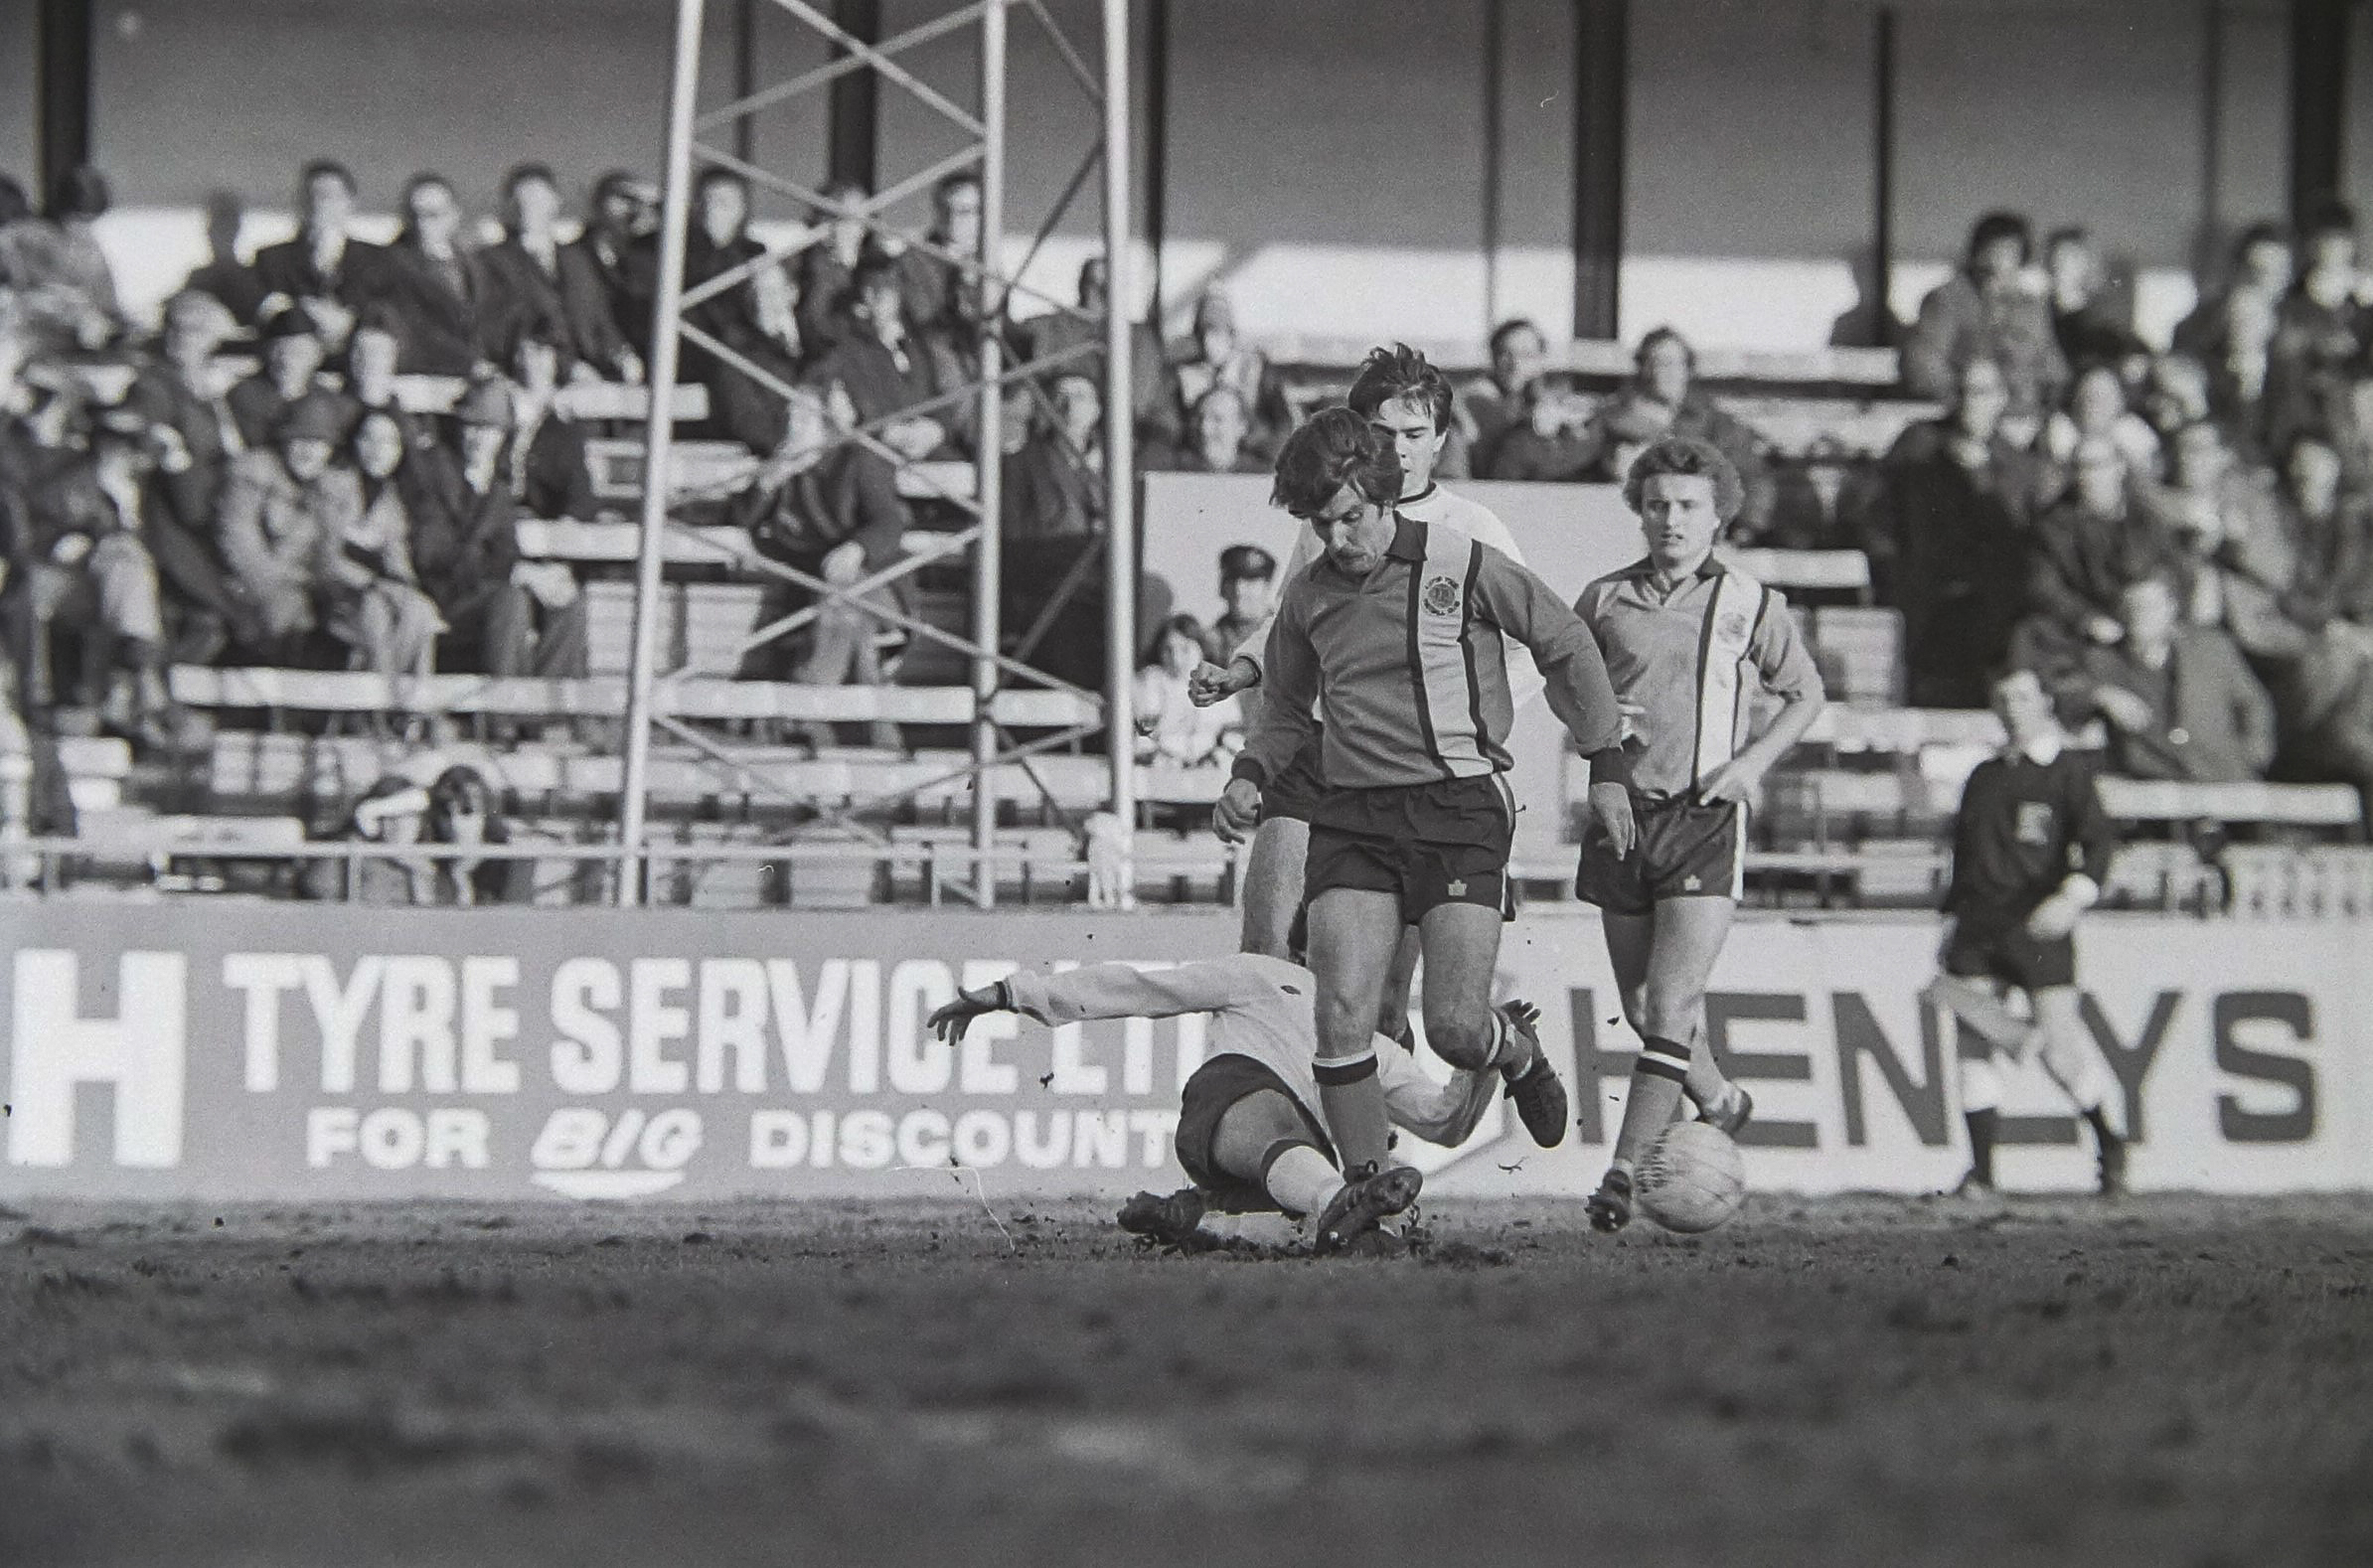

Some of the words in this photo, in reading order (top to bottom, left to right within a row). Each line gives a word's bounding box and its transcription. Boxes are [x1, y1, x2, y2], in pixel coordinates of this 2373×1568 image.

[8, 949, 187, 1169] H
[224, 953, 521, 1094] TYRE
[550, 958, 1021, 1094] SERVICE
[1051, 960, 1208, 1094] LT
[307, 1107, 491, 1170] FOR
[531, 1107, 704, 1170] BIG
